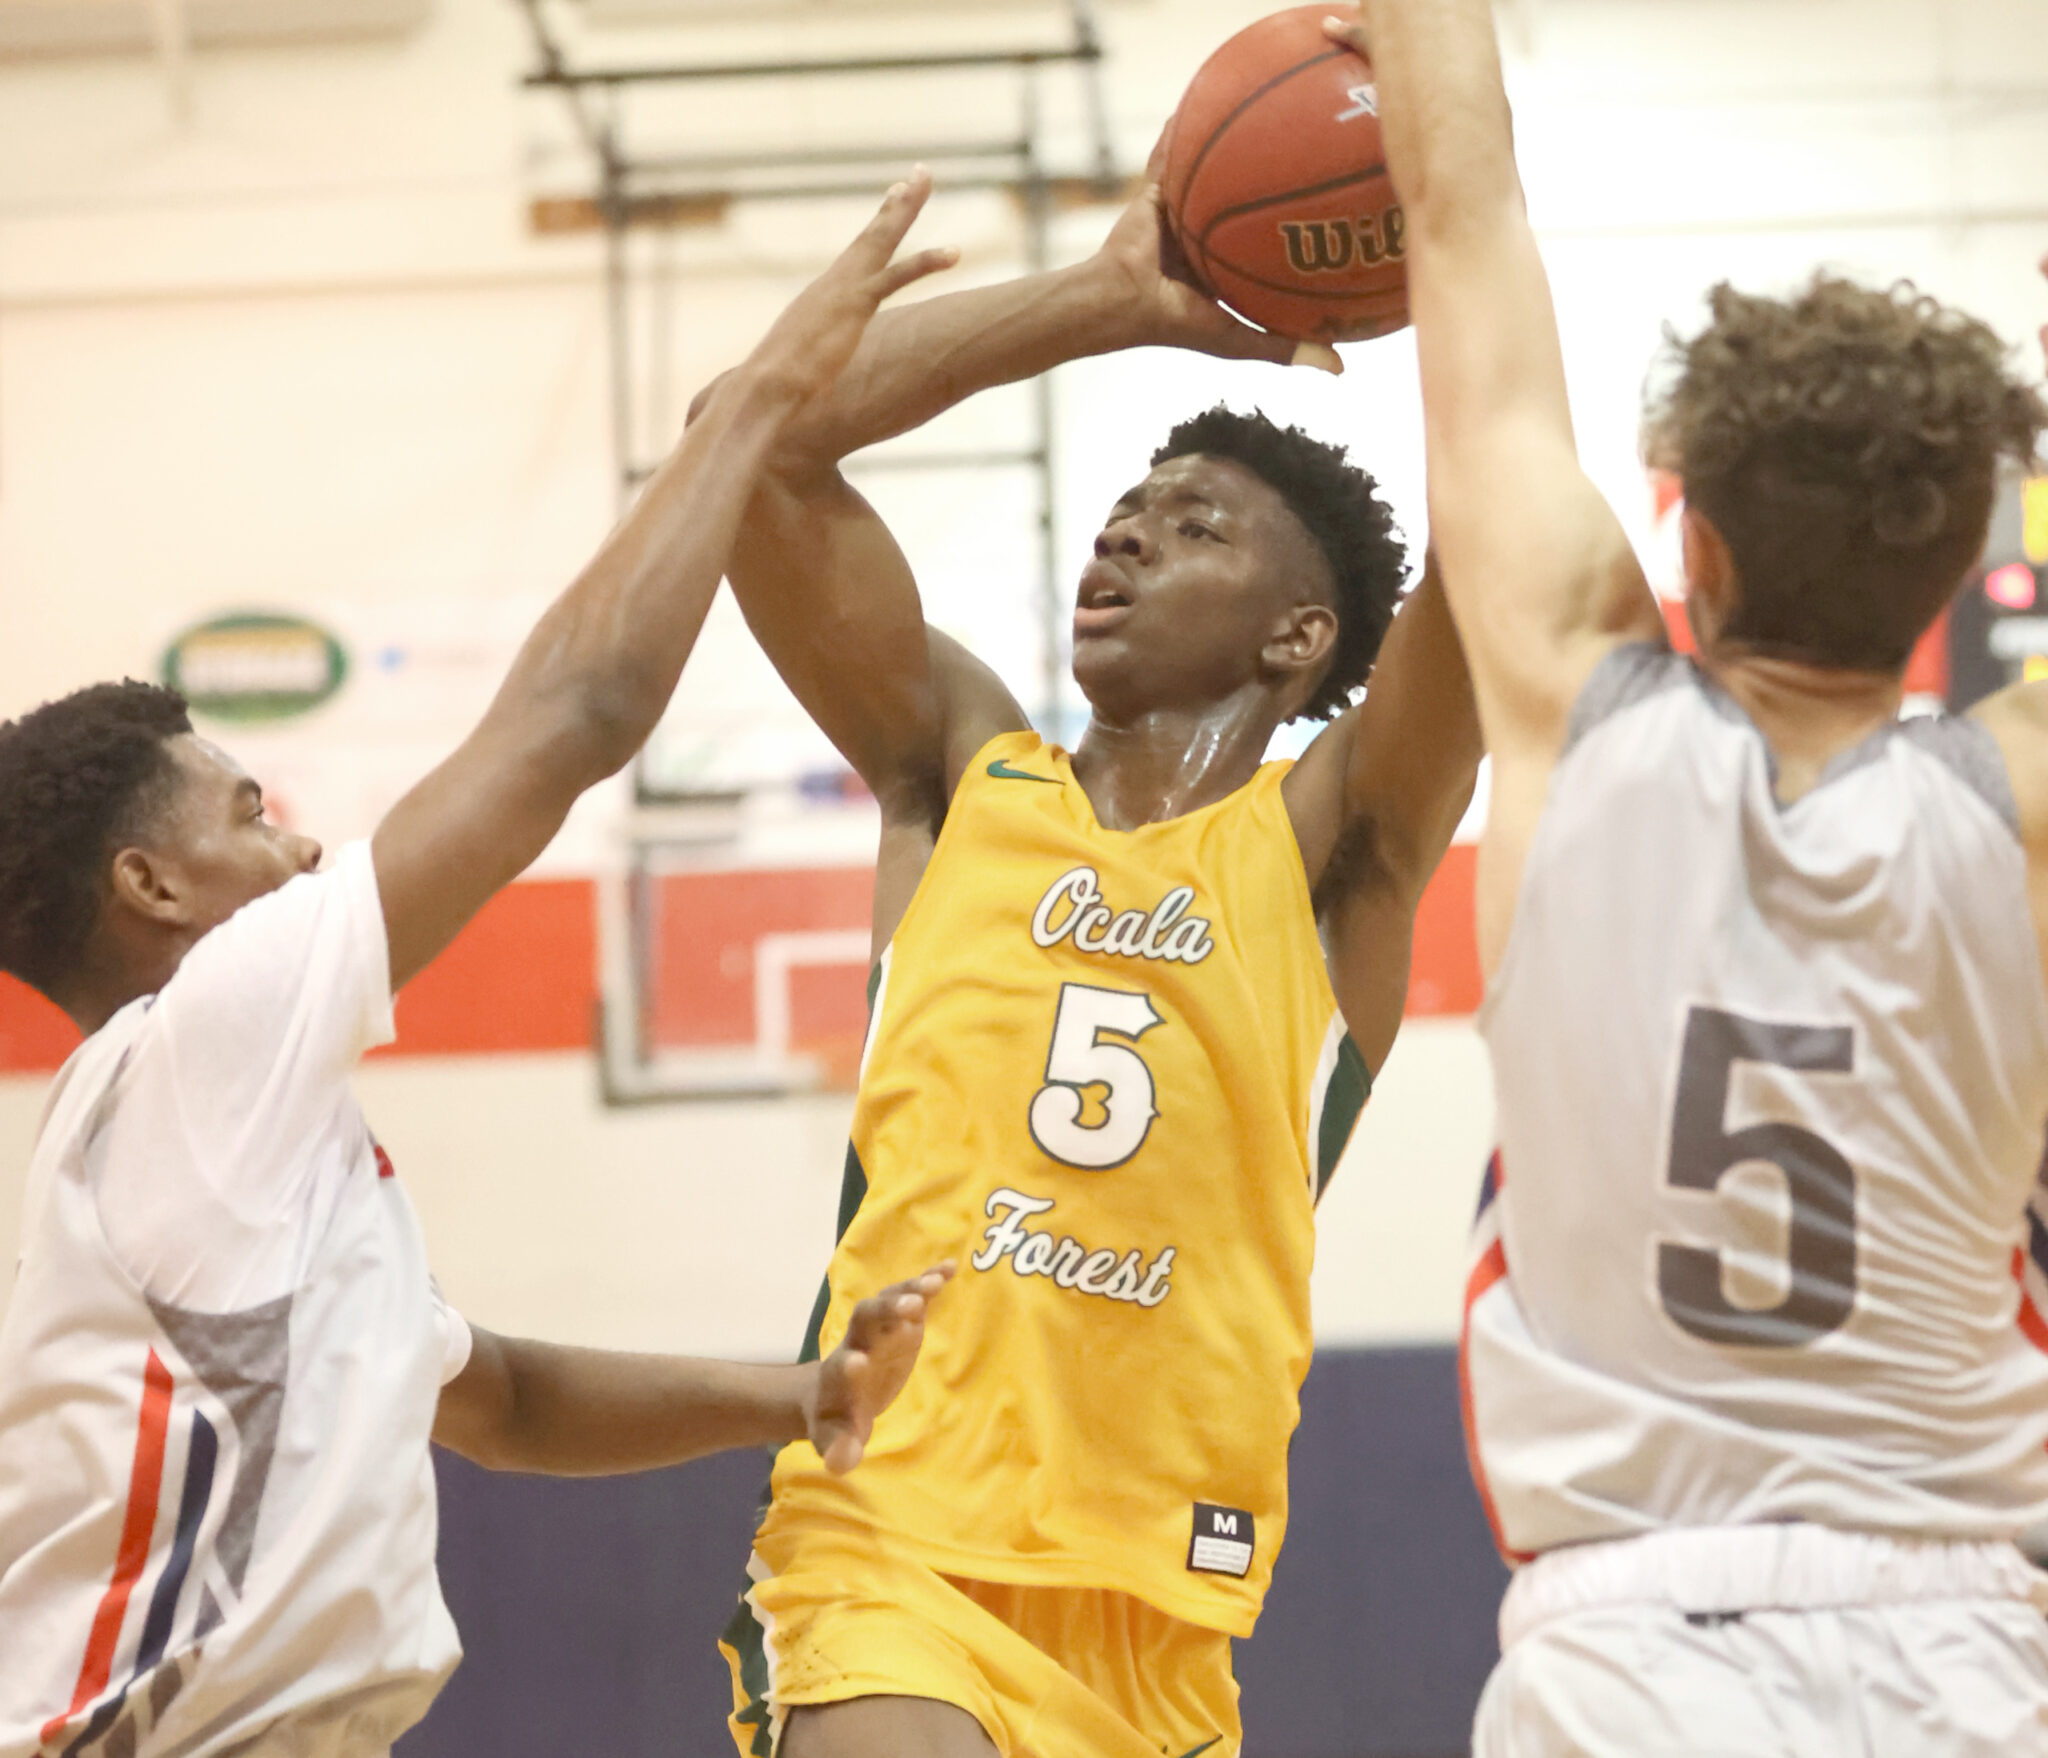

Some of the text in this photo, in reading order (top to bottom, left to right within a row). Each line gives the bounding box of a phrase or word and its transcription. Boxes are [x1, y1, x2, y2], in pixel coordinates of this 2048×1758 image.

[1031, 866, 1214, 964] Ocala
[1028, 982, 1167, 1171] 5
[1656, 1004, 1858, 1348] 5
[972, 1187, 1177, 1308] Forest
[1213, 1512, 1238, 1535] M
